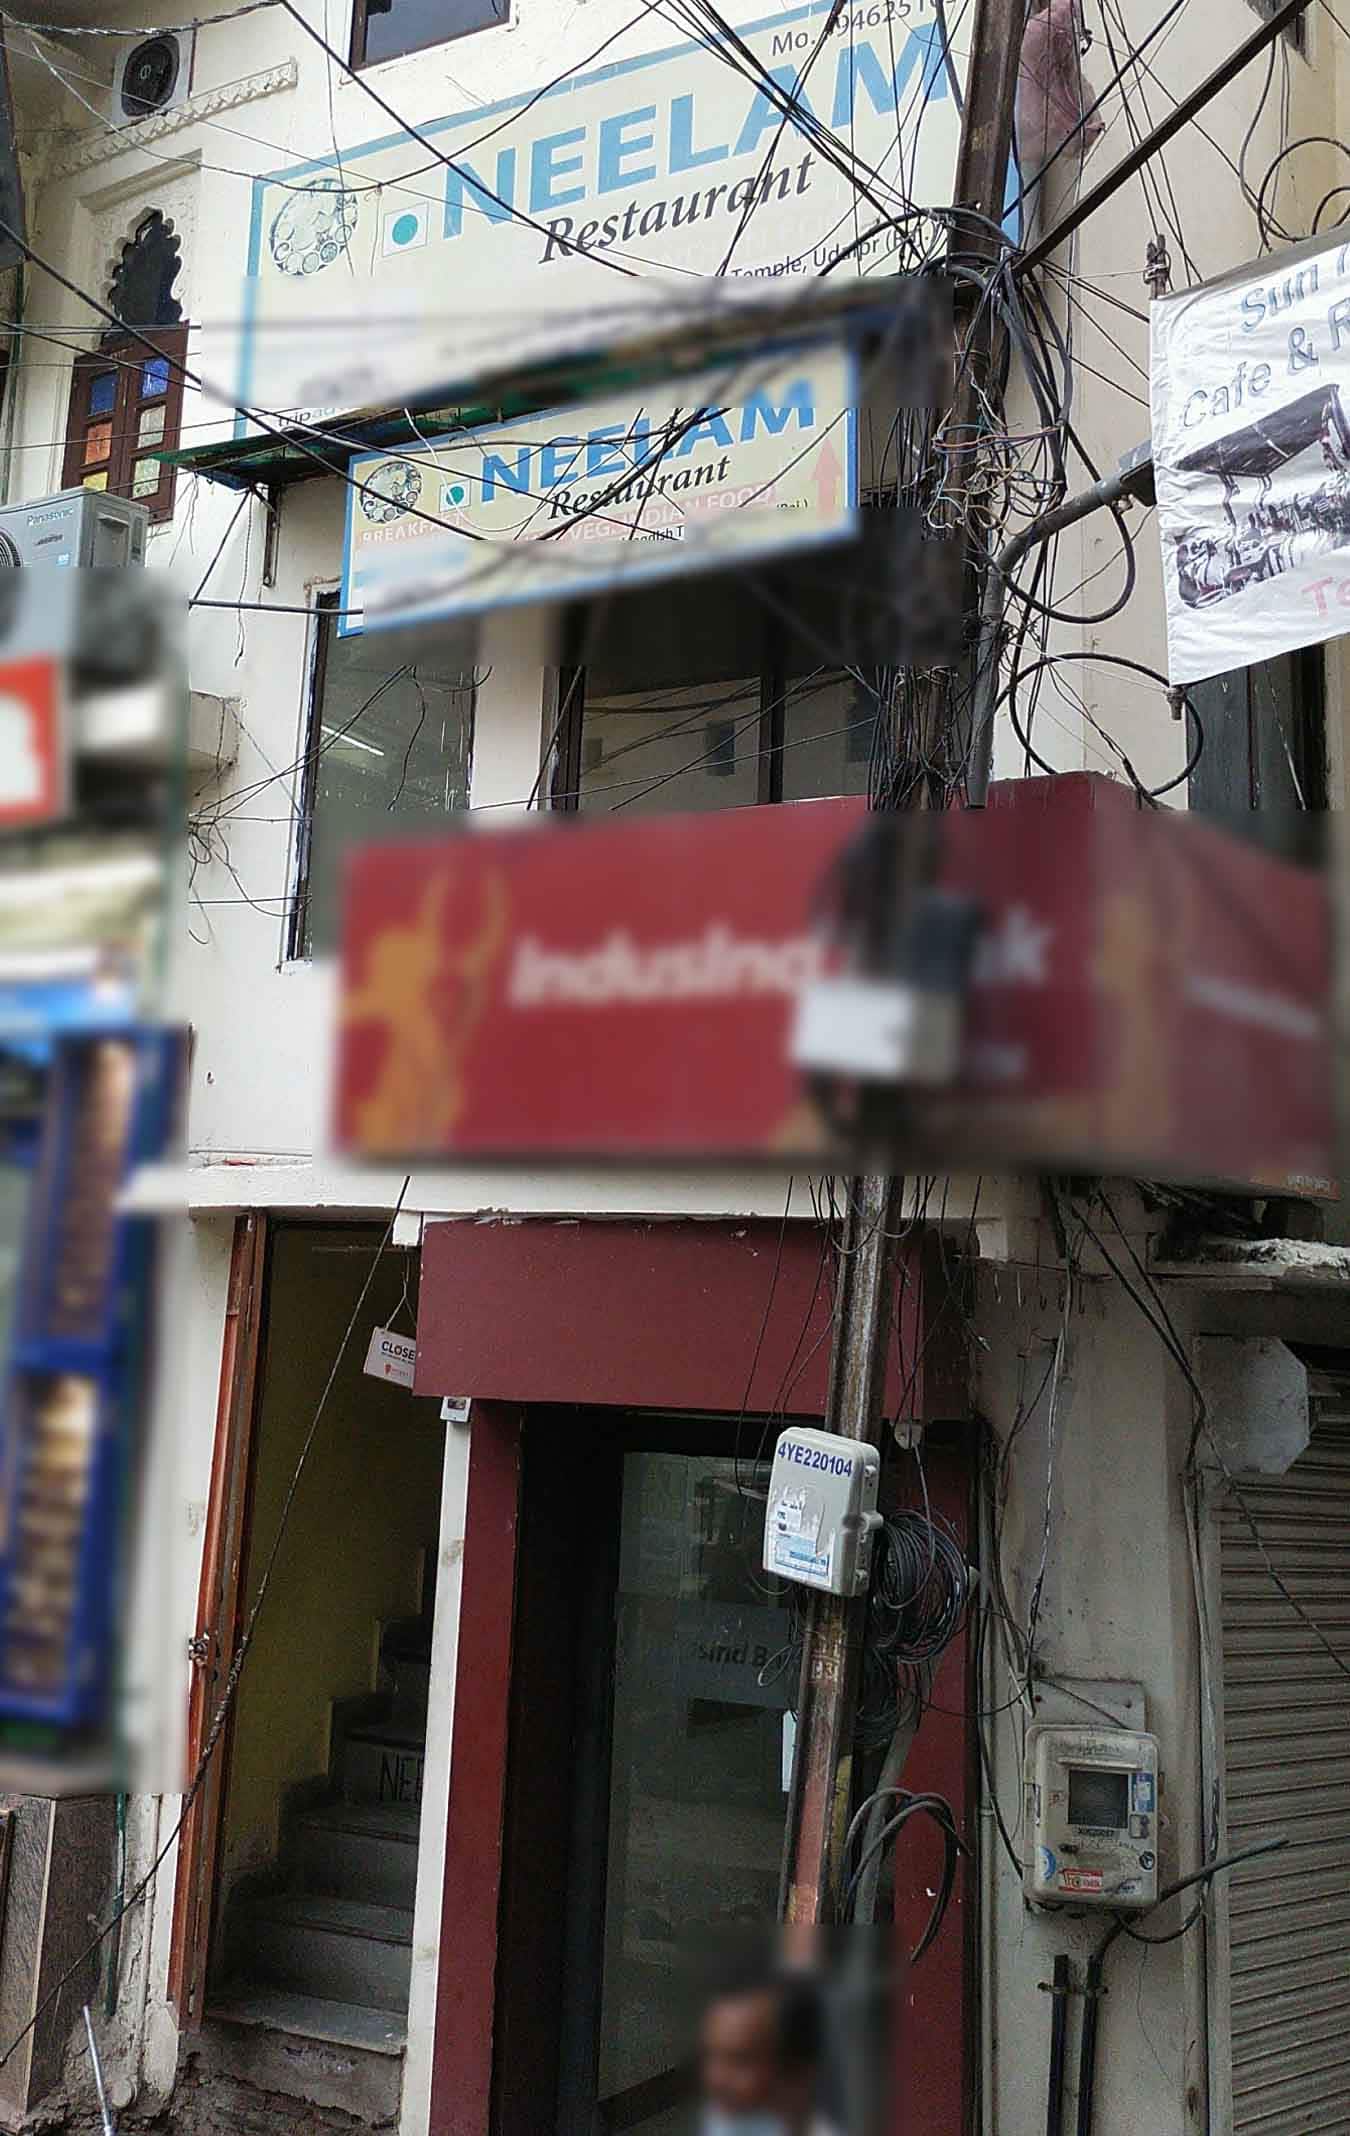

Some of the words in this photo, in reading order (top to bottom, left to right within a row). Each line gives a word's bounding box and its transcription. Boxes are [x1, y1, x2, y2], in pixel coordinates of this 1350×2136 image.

[771, 31, 816, 56] Mo.
[443, 21, 949, 240] NEELAM
[537, 150, 817, 264] Restaurant
[1241, 263, 1319, 333] Sun
[1183, 360, 1271, 428] Cafe
[481, 379, 816, 503] NEELAM
[549, 455, 731, 520] Restaurant
[381, 1340, 416, 1362] CLOSE
[778, 1441, 853, 1477] 4YE220104
